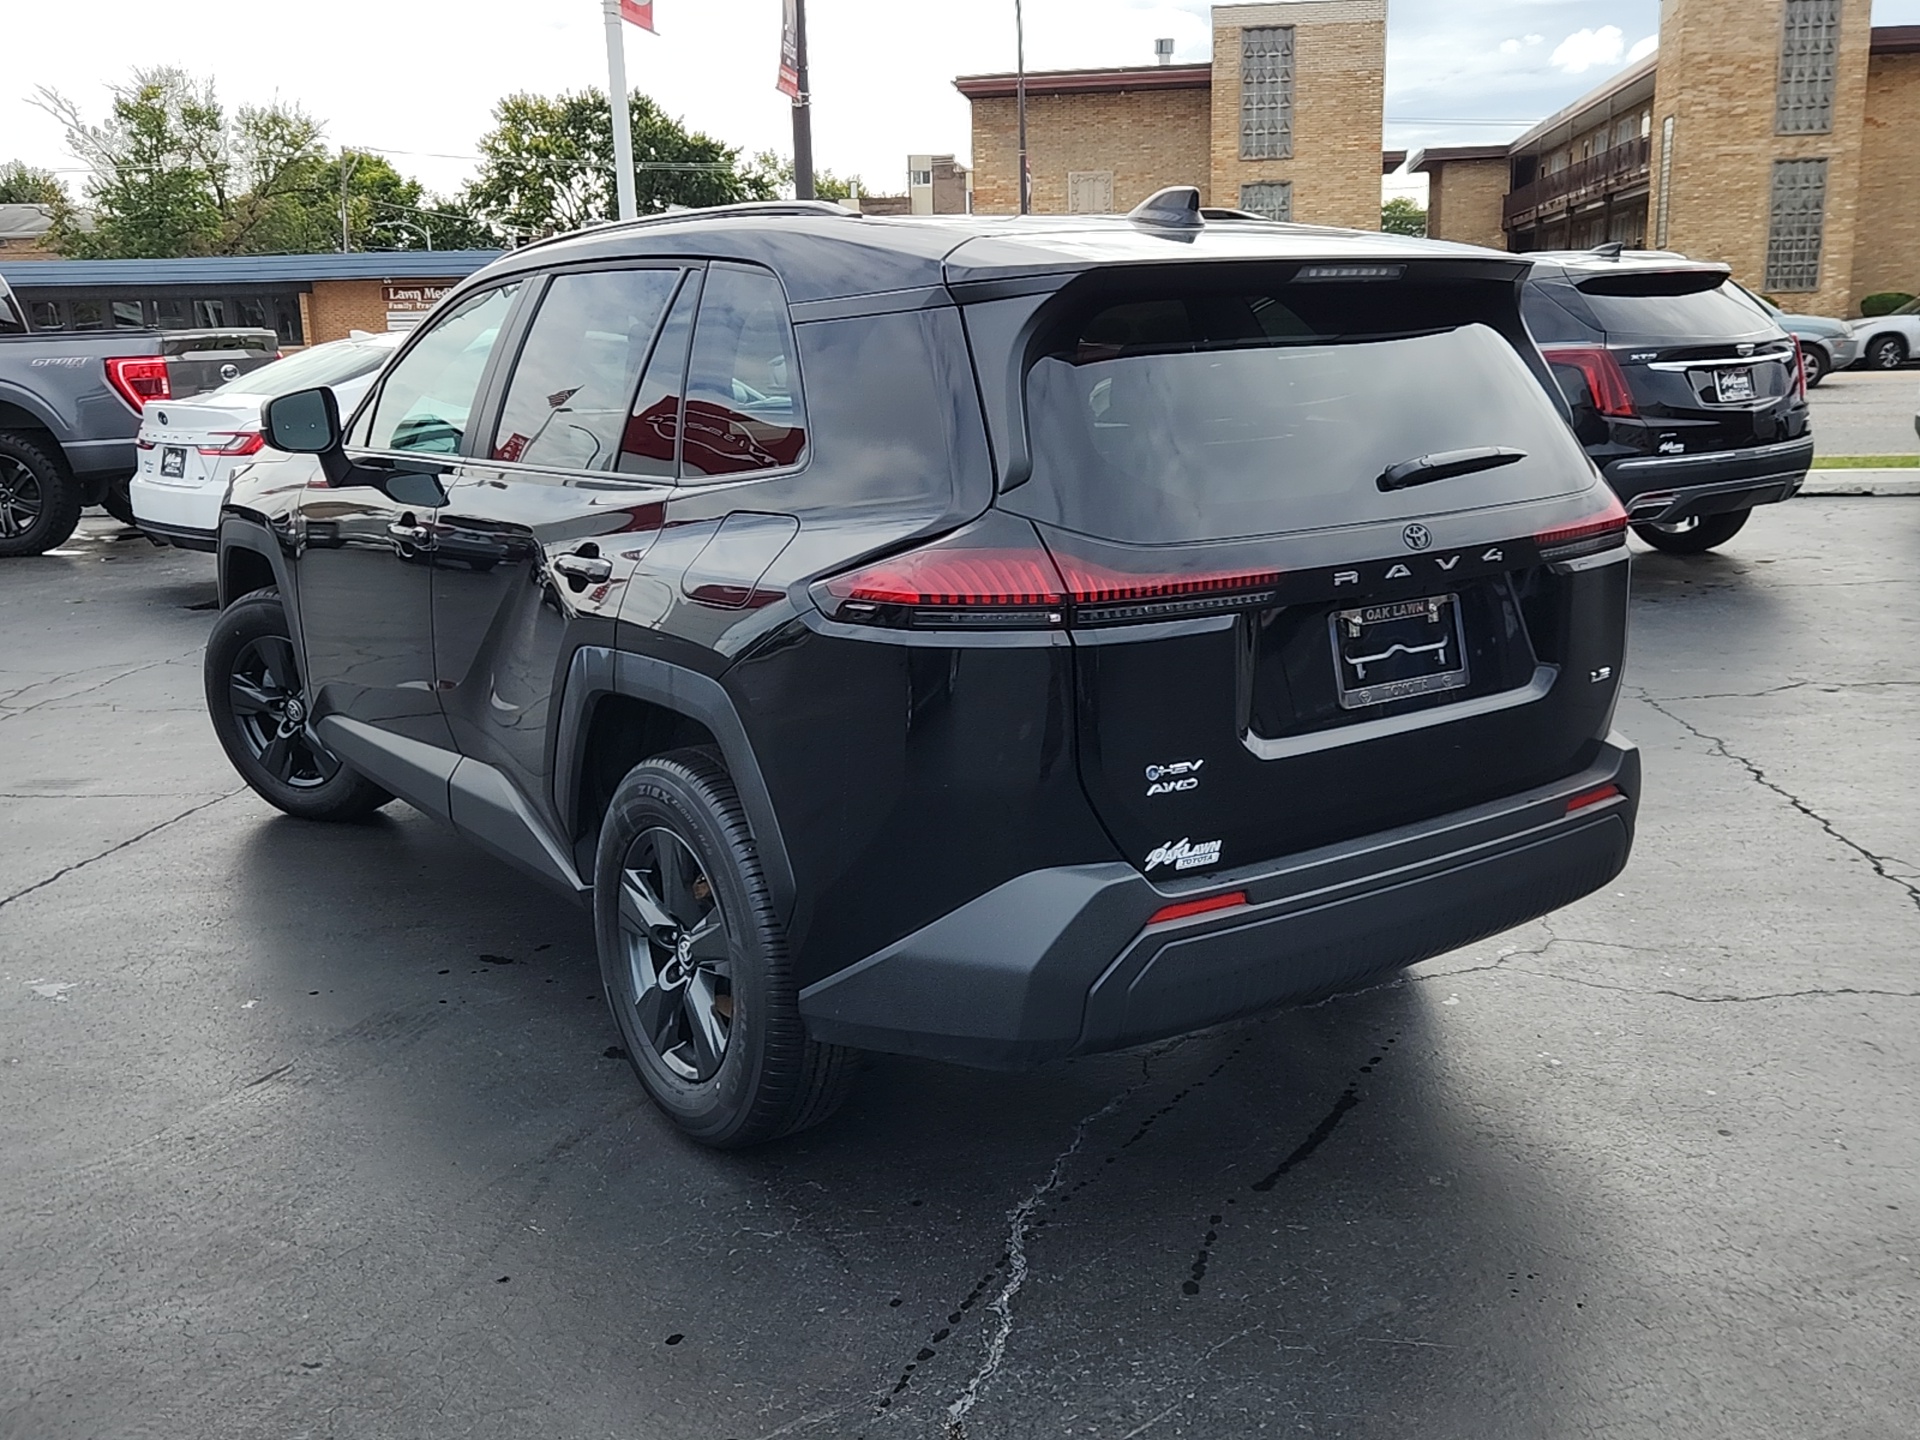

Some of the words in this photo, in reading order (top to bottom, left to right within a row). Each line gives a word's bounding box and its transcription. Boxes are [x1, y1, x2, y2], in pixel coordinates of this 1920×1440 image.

[388, 287, 422, 301] Lawn
[423, 287, 453, 299] Med
[30, 356, 94, 367] SPORT
[1333, 548, 1504, 586] RAV4
[1366, 607, 1391, 621] OAK
[1392, 602, 1425, 616] LAWN
[1382, 679, 1429, 697] TOYOTA
[1146, 777, 1198, 796] AWD
[1181, 854, 1214, 866] TOYOTA
